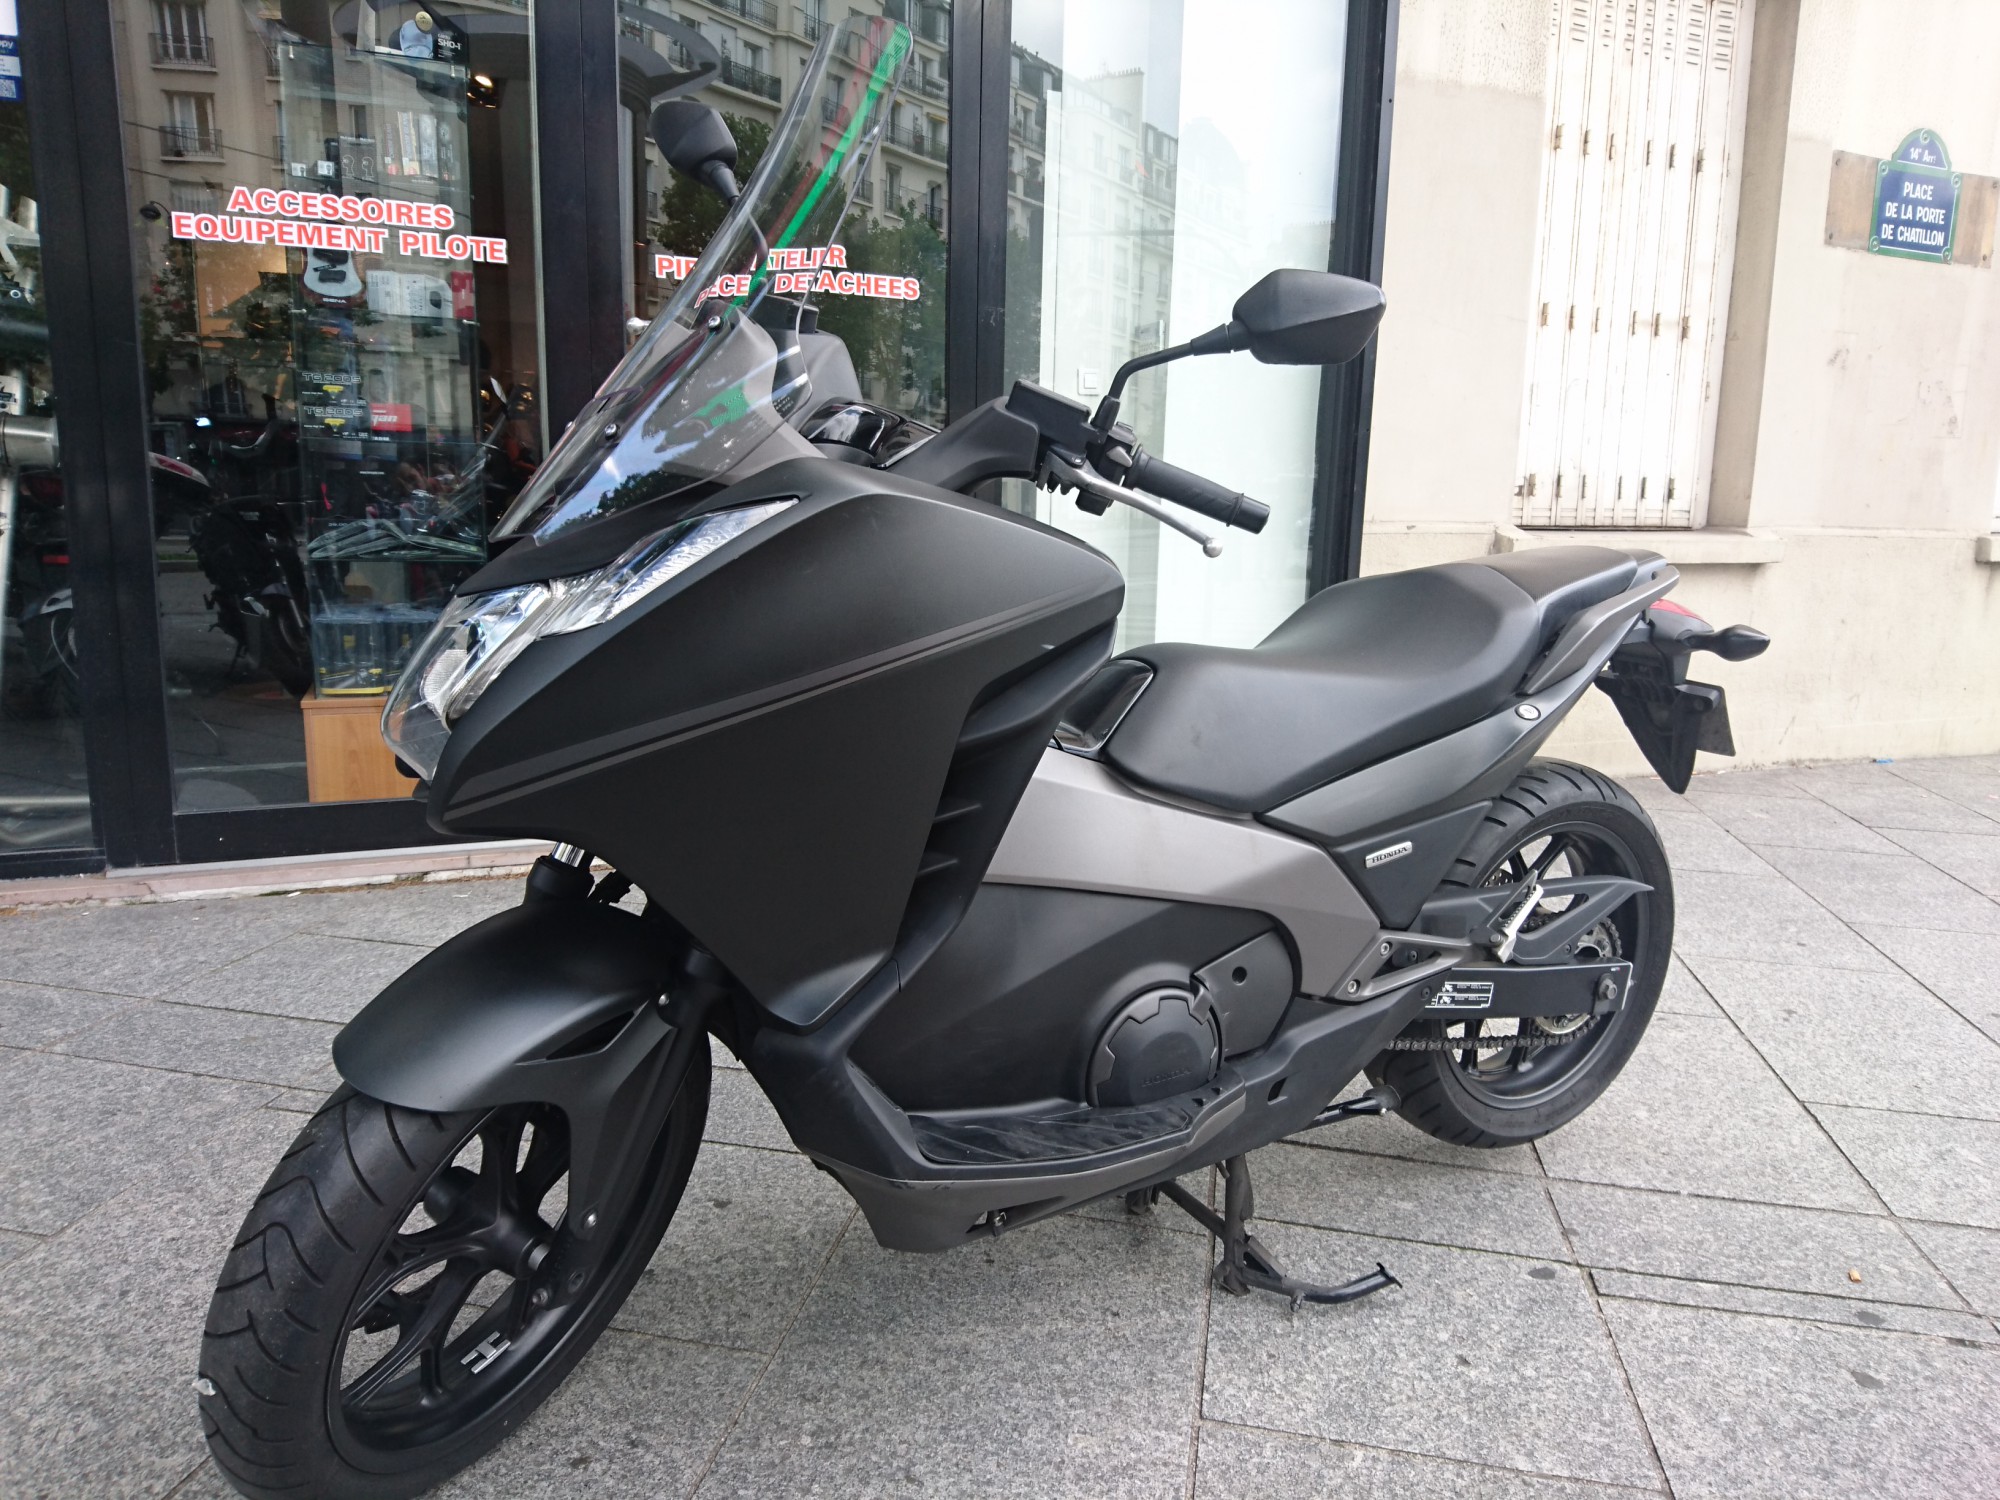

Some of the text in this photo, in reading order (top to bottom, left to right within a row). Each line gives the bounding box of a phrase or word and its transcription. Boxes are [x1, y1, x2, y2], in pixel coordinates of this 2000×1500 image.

[1903, 181, 1934, 201] PLACE
[227, 186, 455, 229] ACCESSOIRES
[1885, 201, 1946, 225] DE LA PORTE
[171, 212, 508, 264] EQUIPEMENT PILOTE
[1881, 223, 1945, 247] DE CHATILLON
[1371, 847, 1408, 863] HONDA
